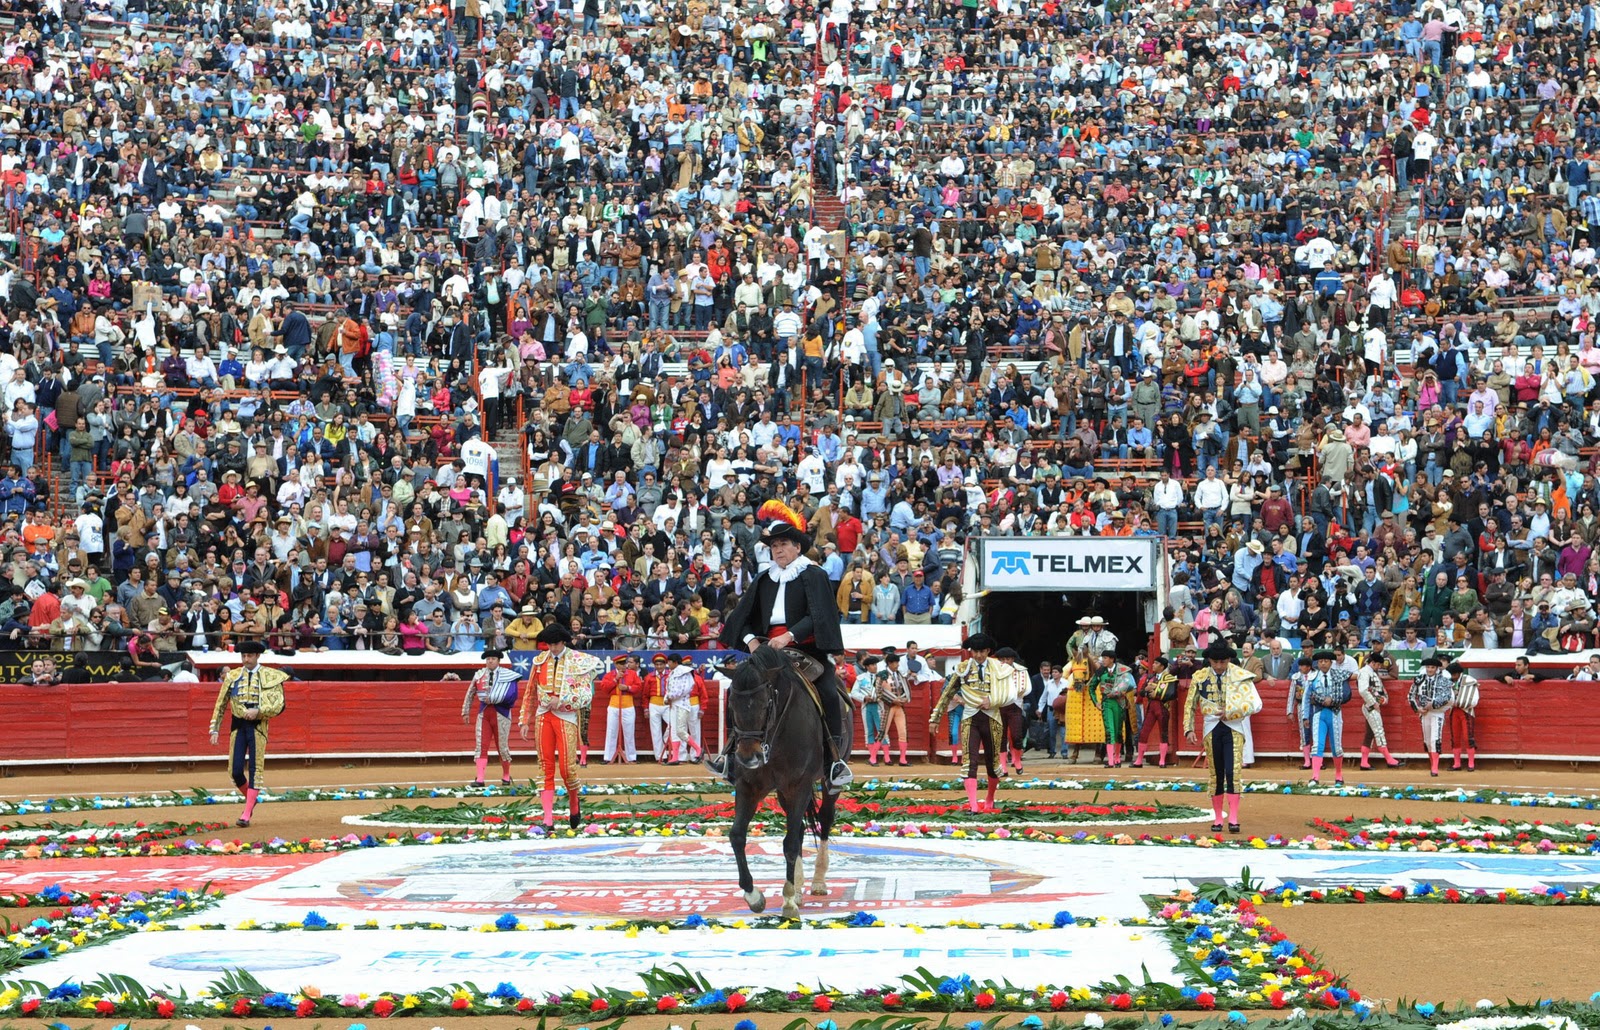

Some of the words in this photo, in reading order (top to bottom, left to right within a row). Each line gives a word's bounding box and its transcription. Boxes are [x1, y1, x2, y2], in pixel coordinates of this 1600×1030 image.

[1033, 555, 1143, 573] TELMEX
[363, 902, 557, 910] TEMPORADA
[383, 949, 1073, 959] EUROCOPTER
